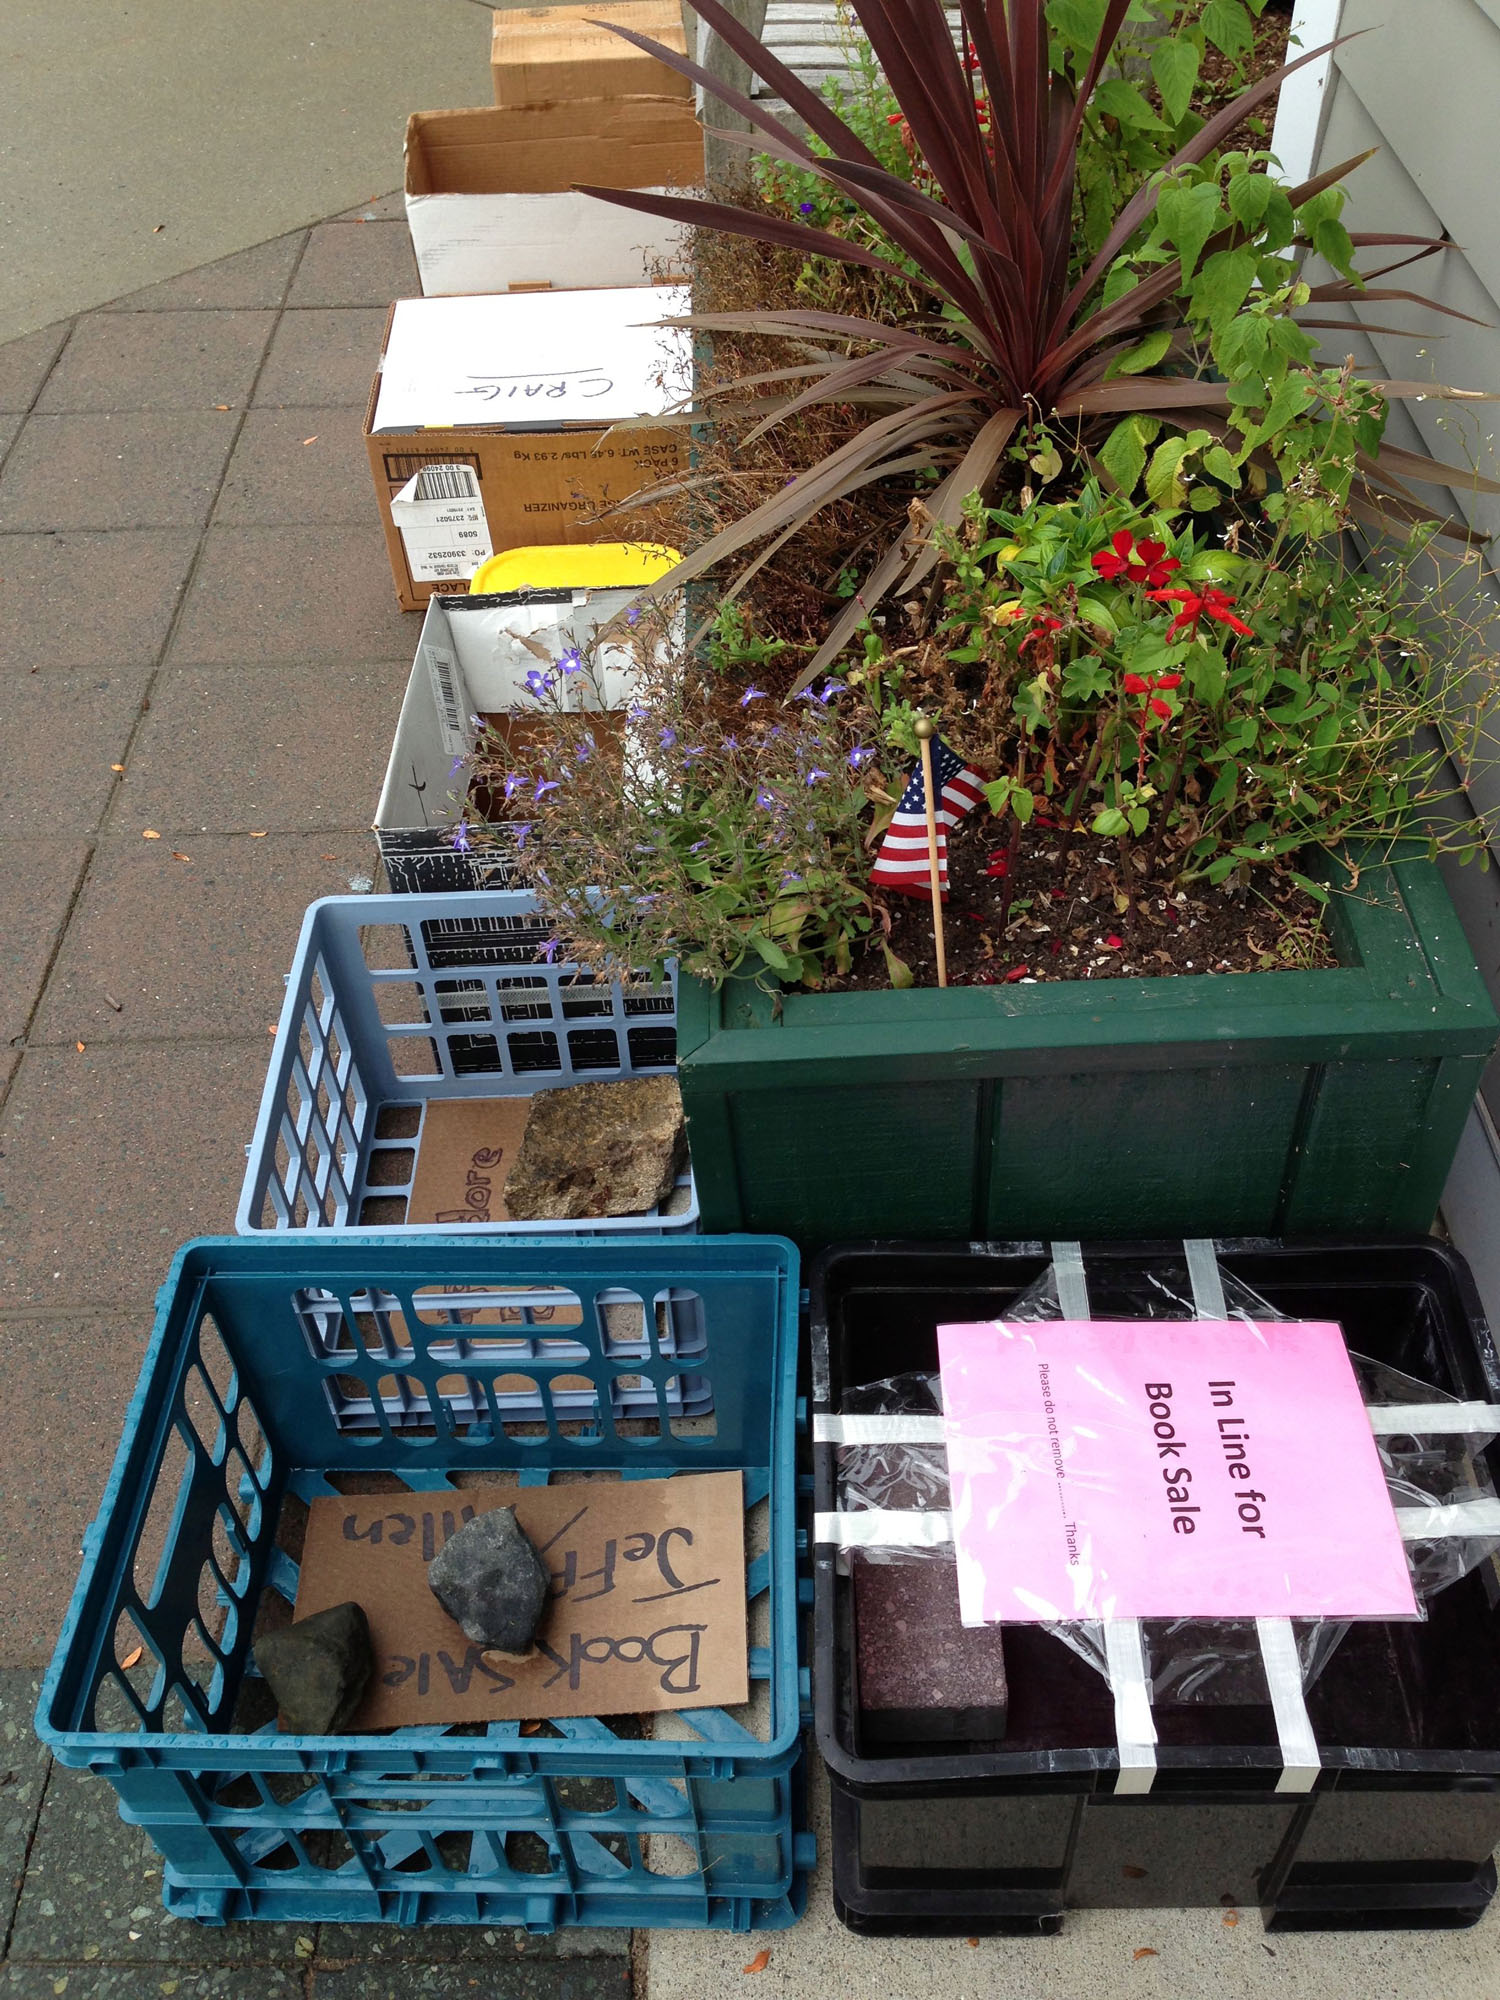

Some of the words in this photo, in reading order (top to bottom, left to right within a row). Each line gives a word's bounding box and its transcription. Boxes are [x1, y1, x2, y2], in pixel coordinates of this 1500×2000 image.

[454, 379, 613, 401] CRAIG
[514, 451, 530, 461] Kg
[534, 452, 558, 461] 2.93
[618, 447, 640, 458] WT:
[643, 444, 677, 456] CASE
[672, 457, 678, 465] 6
[428, 550, 466, 559] 33902532
[432, 583, 470, 593] LACE
[1038, 1363, 1051, 1398] Please
[1208, 1381, 1236, 1407] In
[1044, 1400, 1055, 1414] do
[1047, 1416, 1058, 1435] not
[1145, 1383, 1187, 1459] Book
[1051, 1436, 1065, 1479] remove
[1217, 1418, 1250, 1479] Line
[1163, 1467, 1201, 1534] Sale
[1234, 1489, 1266, 1539] for
[343, 1504, 490, 1562] llen
[1065, 1522, 1079, 1566] Thanks
